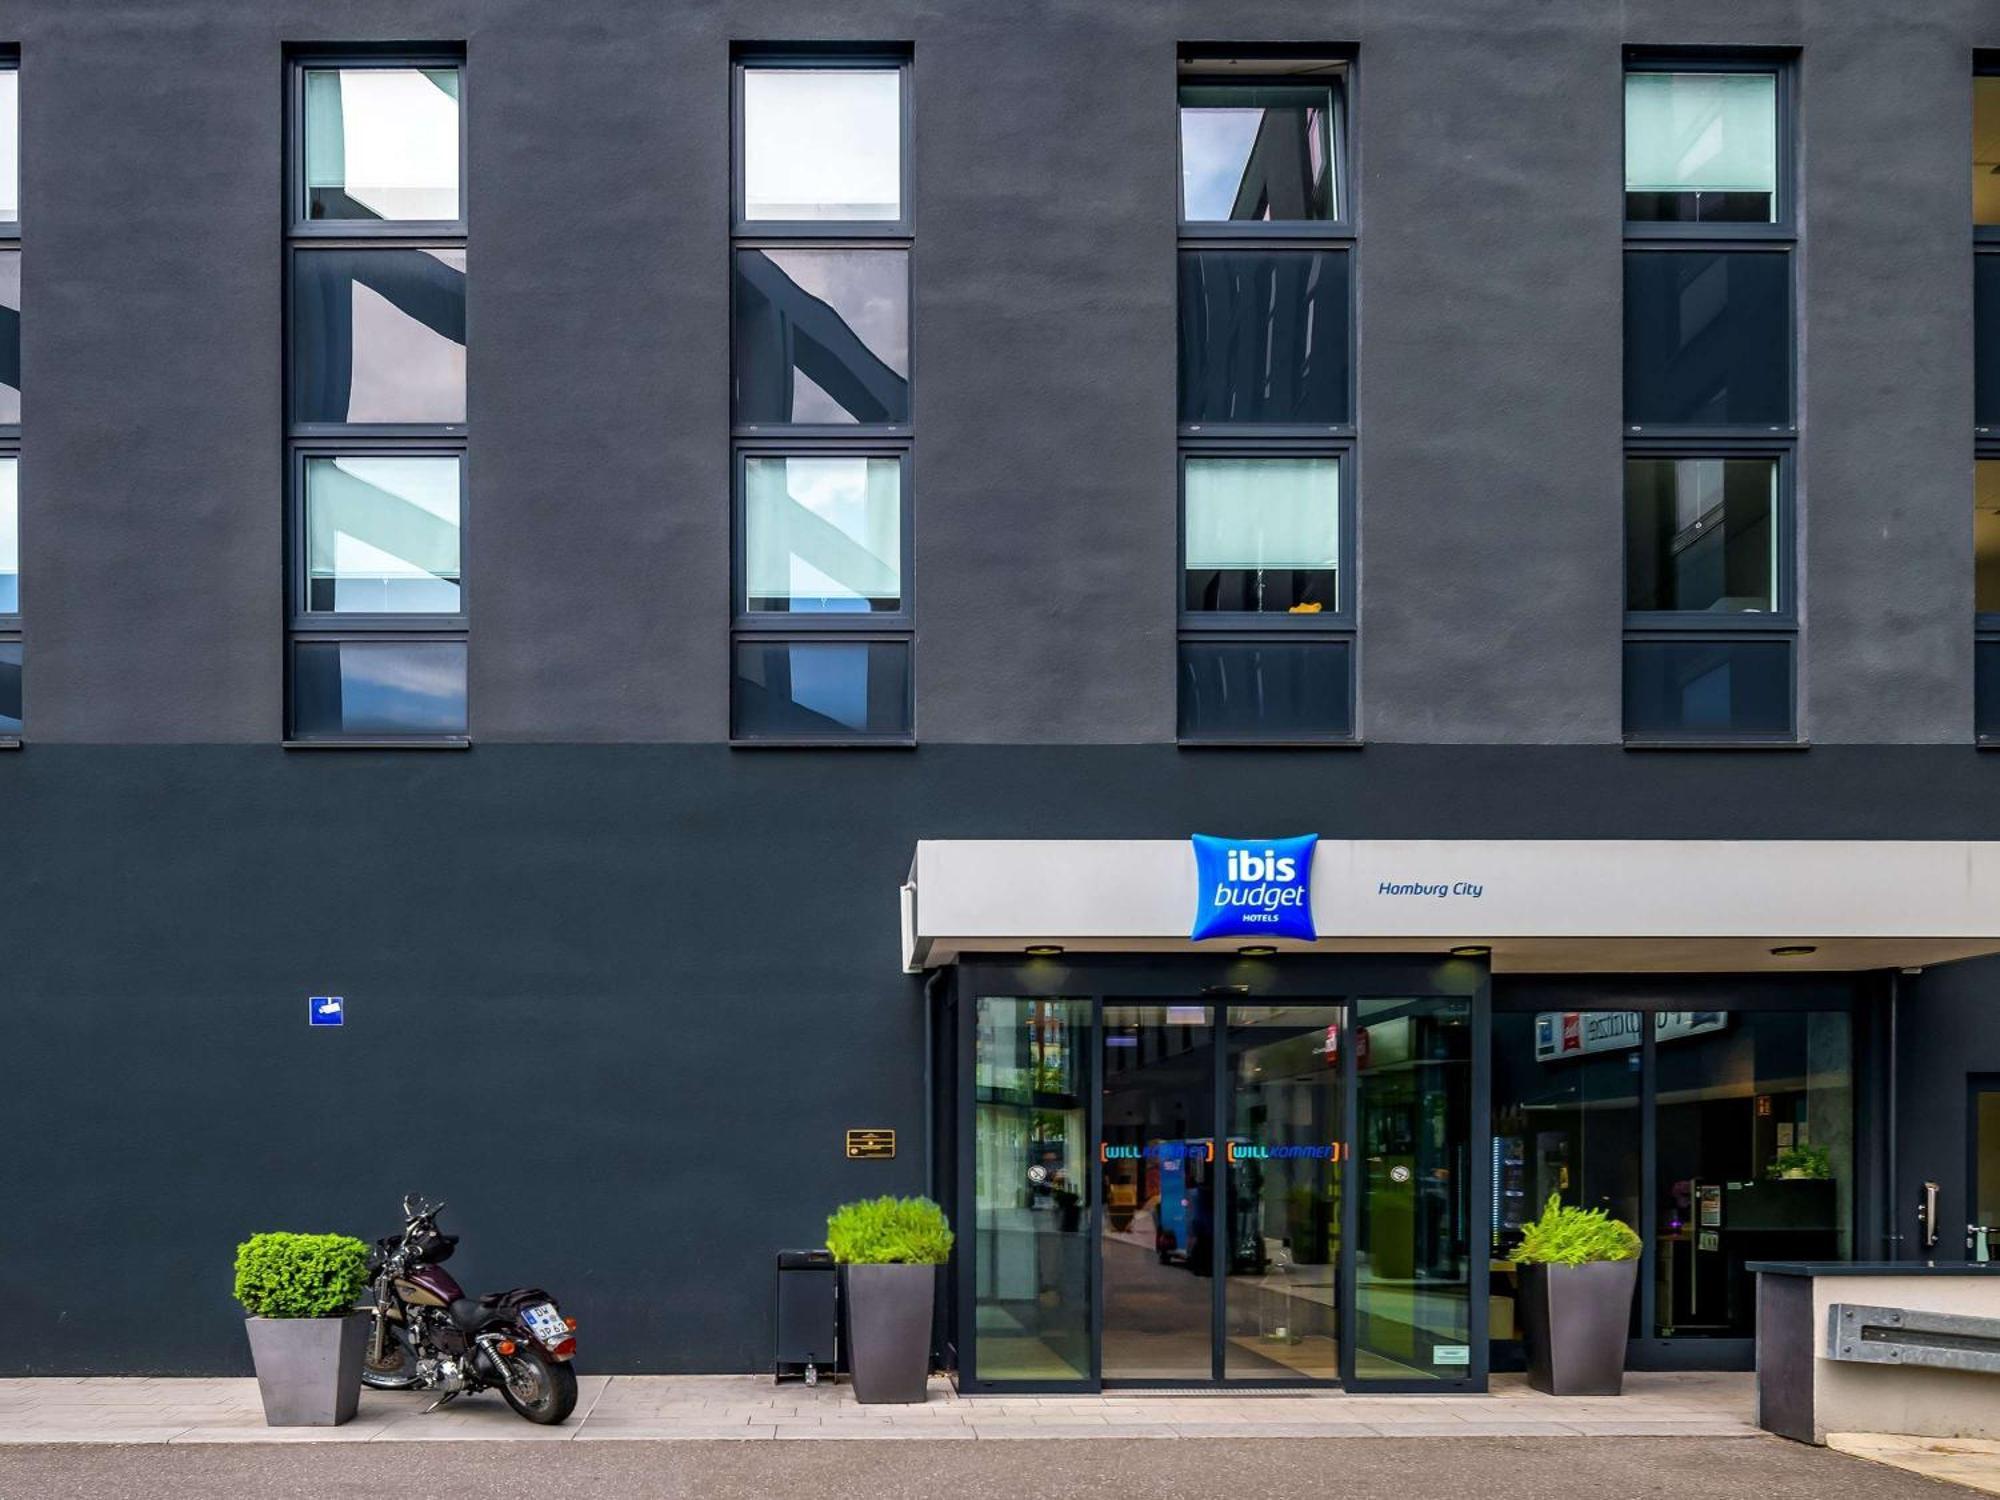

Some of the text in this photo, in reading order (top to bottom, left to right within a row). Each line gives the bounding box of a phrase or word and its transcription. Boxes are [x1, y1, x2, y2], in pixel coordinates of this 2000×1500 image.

[1228, 850, 1296, 882] ibis
[1214, 882, 1305, 912] budget
[1378, 882, 1483, 898] Hamburg City
[1242, 914, 1279, 922] HOTELS
